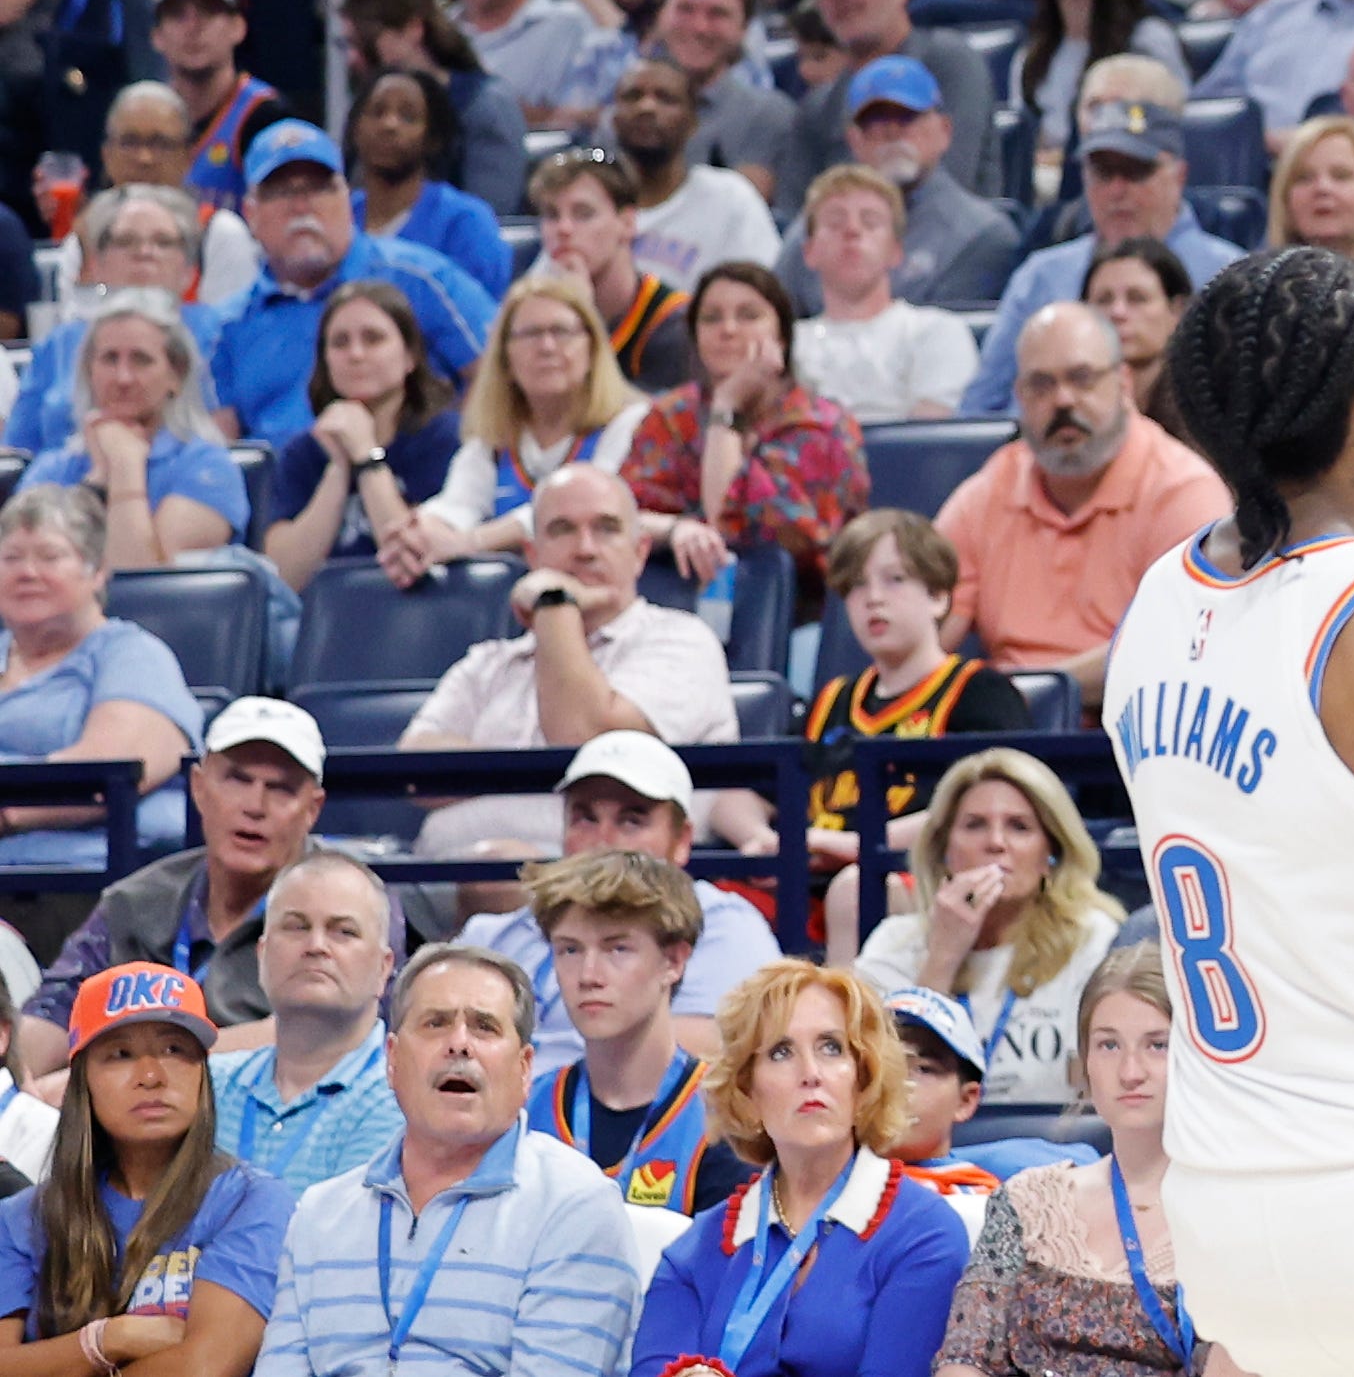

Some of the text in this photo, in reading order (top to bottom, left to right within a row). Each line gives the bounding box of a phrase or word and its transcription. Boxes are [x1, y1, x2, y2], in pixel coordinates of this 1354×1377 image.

[1116, 681, 1277, 794] WILLIAMS
[105, 970, 185, 1016] OKC
[1152, 833, 1266, 1064] 8
